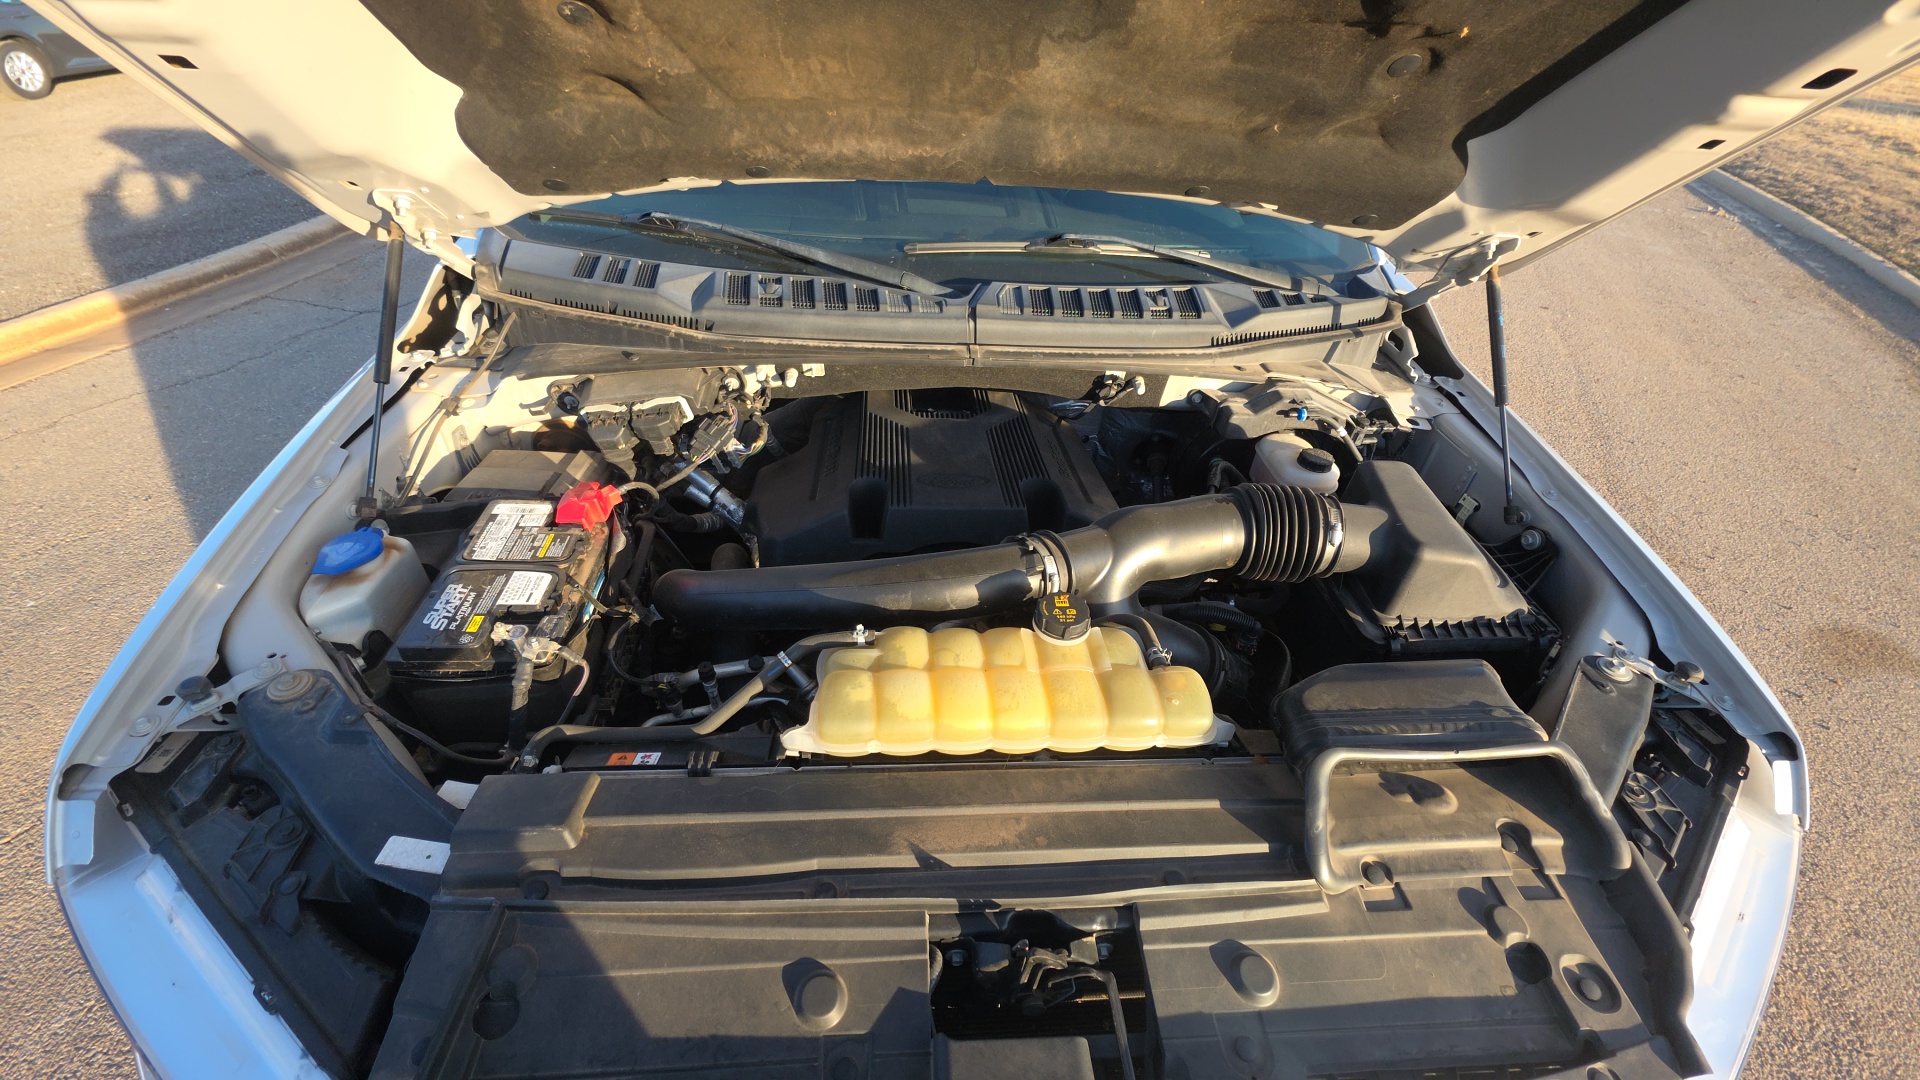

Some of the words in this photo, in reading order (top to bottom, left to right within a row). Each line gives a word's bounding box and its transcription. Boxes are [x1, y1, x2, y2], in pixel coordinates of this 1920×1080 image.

[422, 583, 458, 625] SUPER
[430, 583, 468, 631] START
[448, 592, 477, 630] PLATINUM
